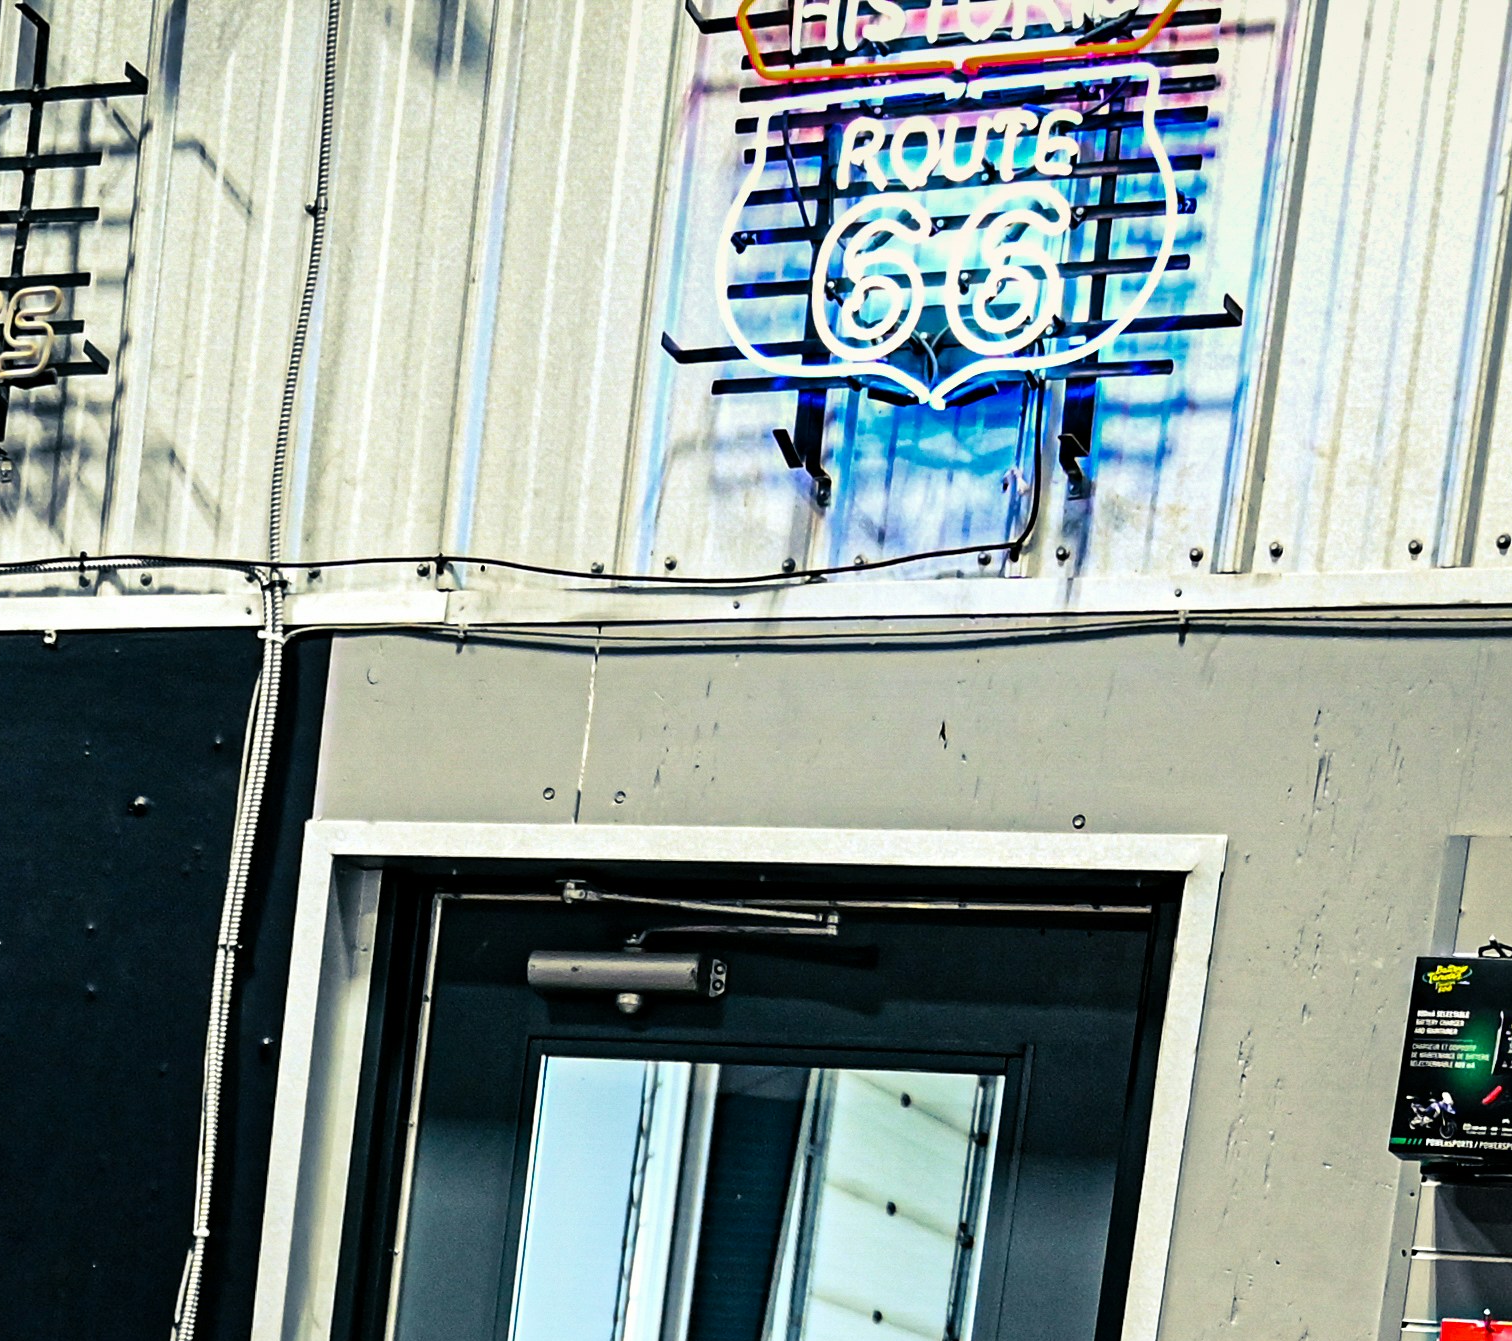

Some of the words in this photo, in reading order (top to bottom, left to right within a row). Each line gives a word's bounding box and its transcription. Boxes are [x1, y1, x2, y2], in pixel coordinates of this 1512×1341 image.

[837, 110, 1083, 190] ROUTE
[813, 183, 1074, 361] 66
[1426, 1137, 1473, 1148] POWERSPORTS
